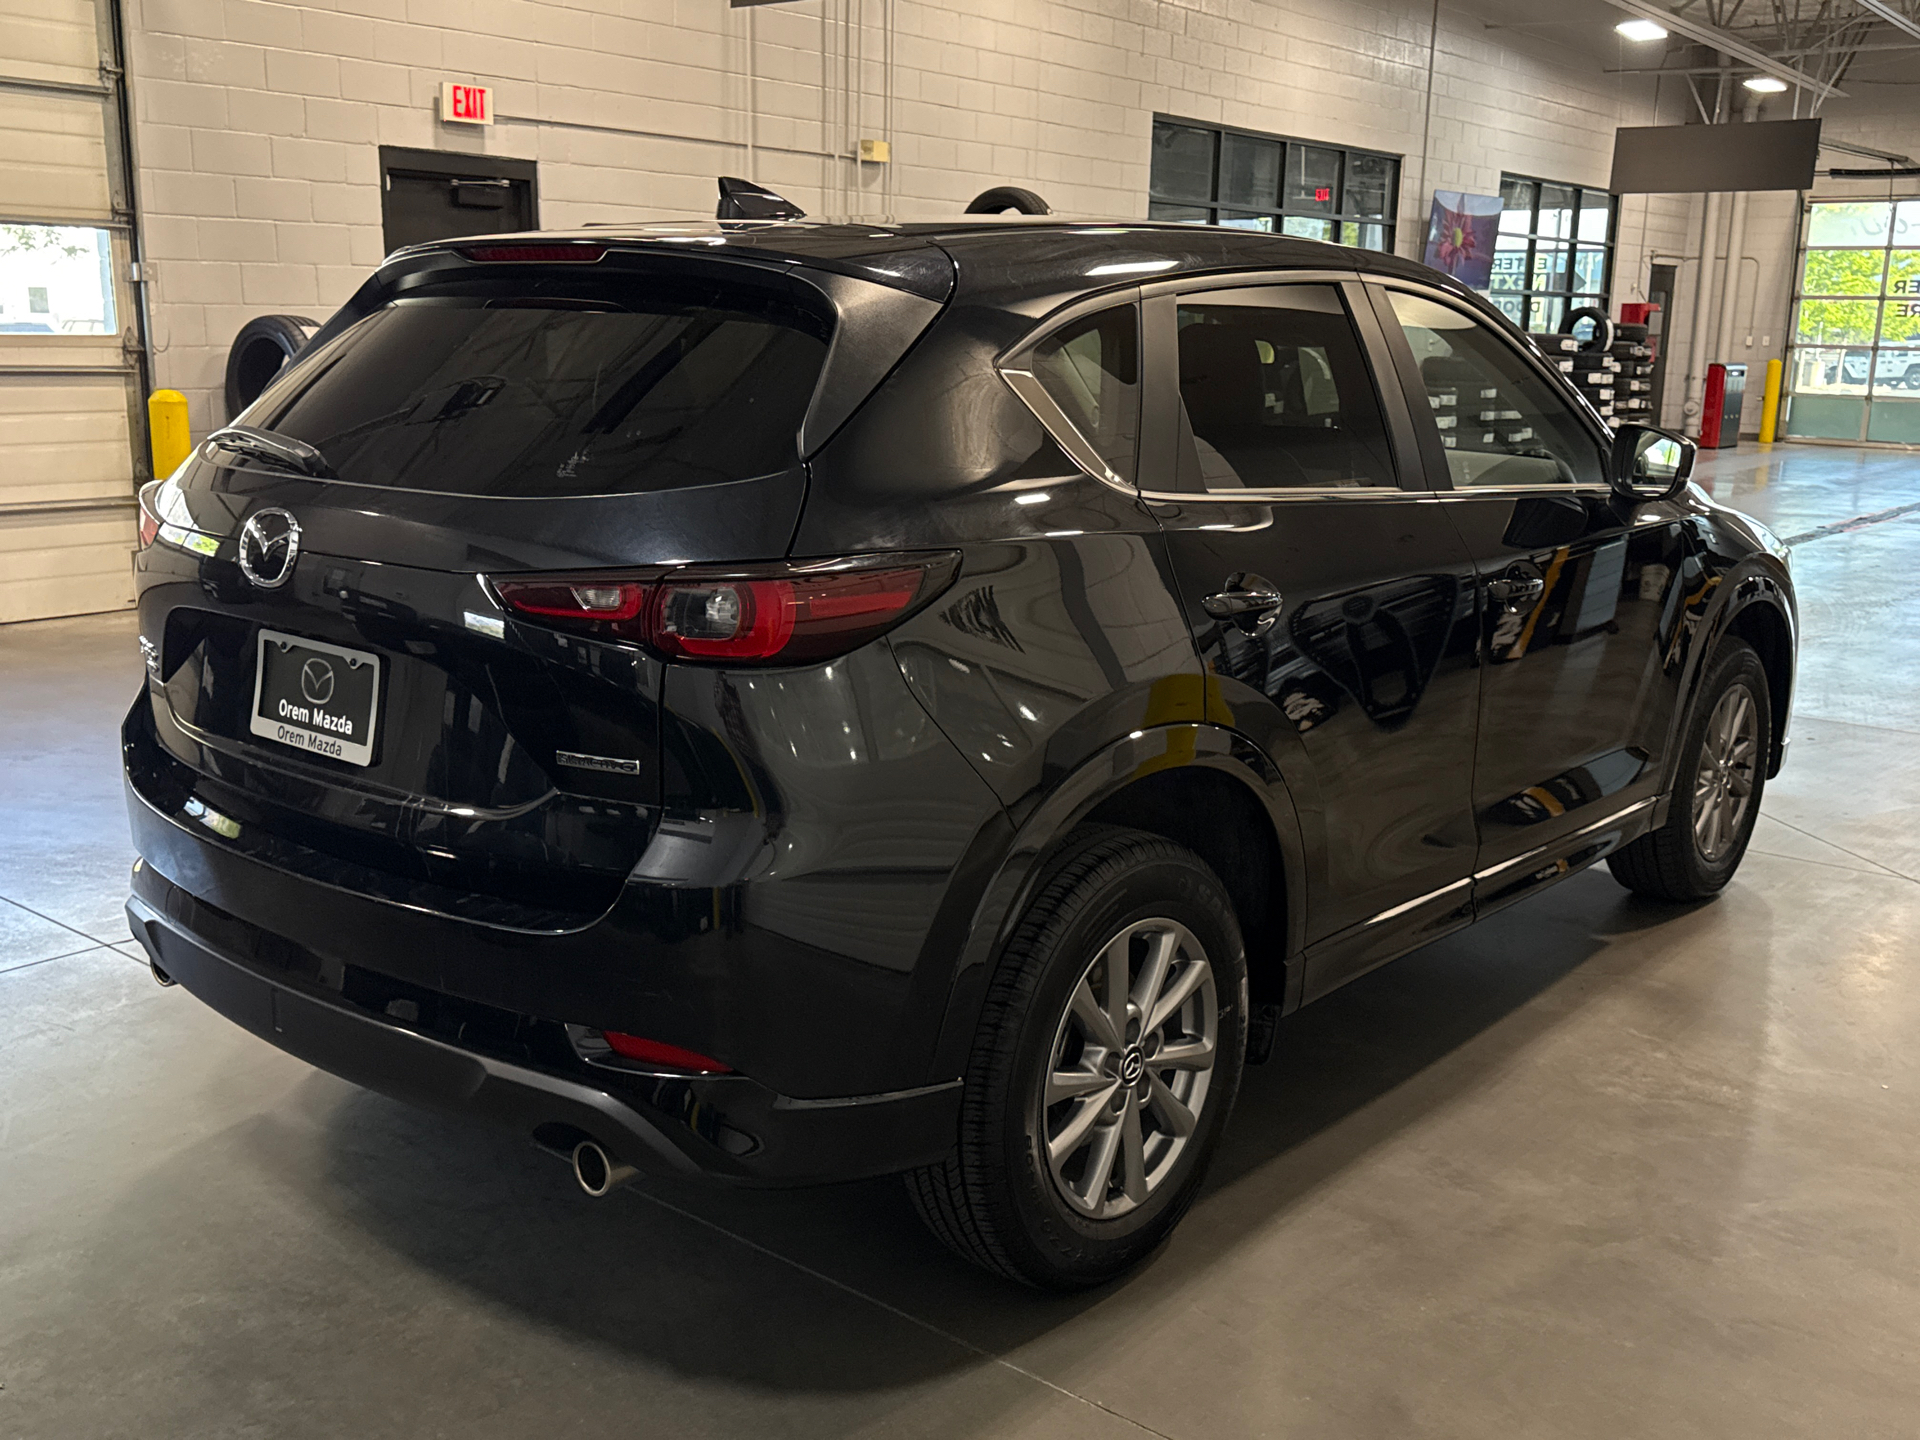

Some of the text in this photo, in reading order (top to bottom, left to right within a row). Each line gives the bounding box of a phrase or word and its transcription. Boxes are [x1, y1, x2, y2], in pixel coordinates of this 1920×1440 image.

[452, 85, 486, 120] EXIT
[278, 698, 354, 735] Orem Mazda
[277, 725, 343, 757] Orem Mazda
